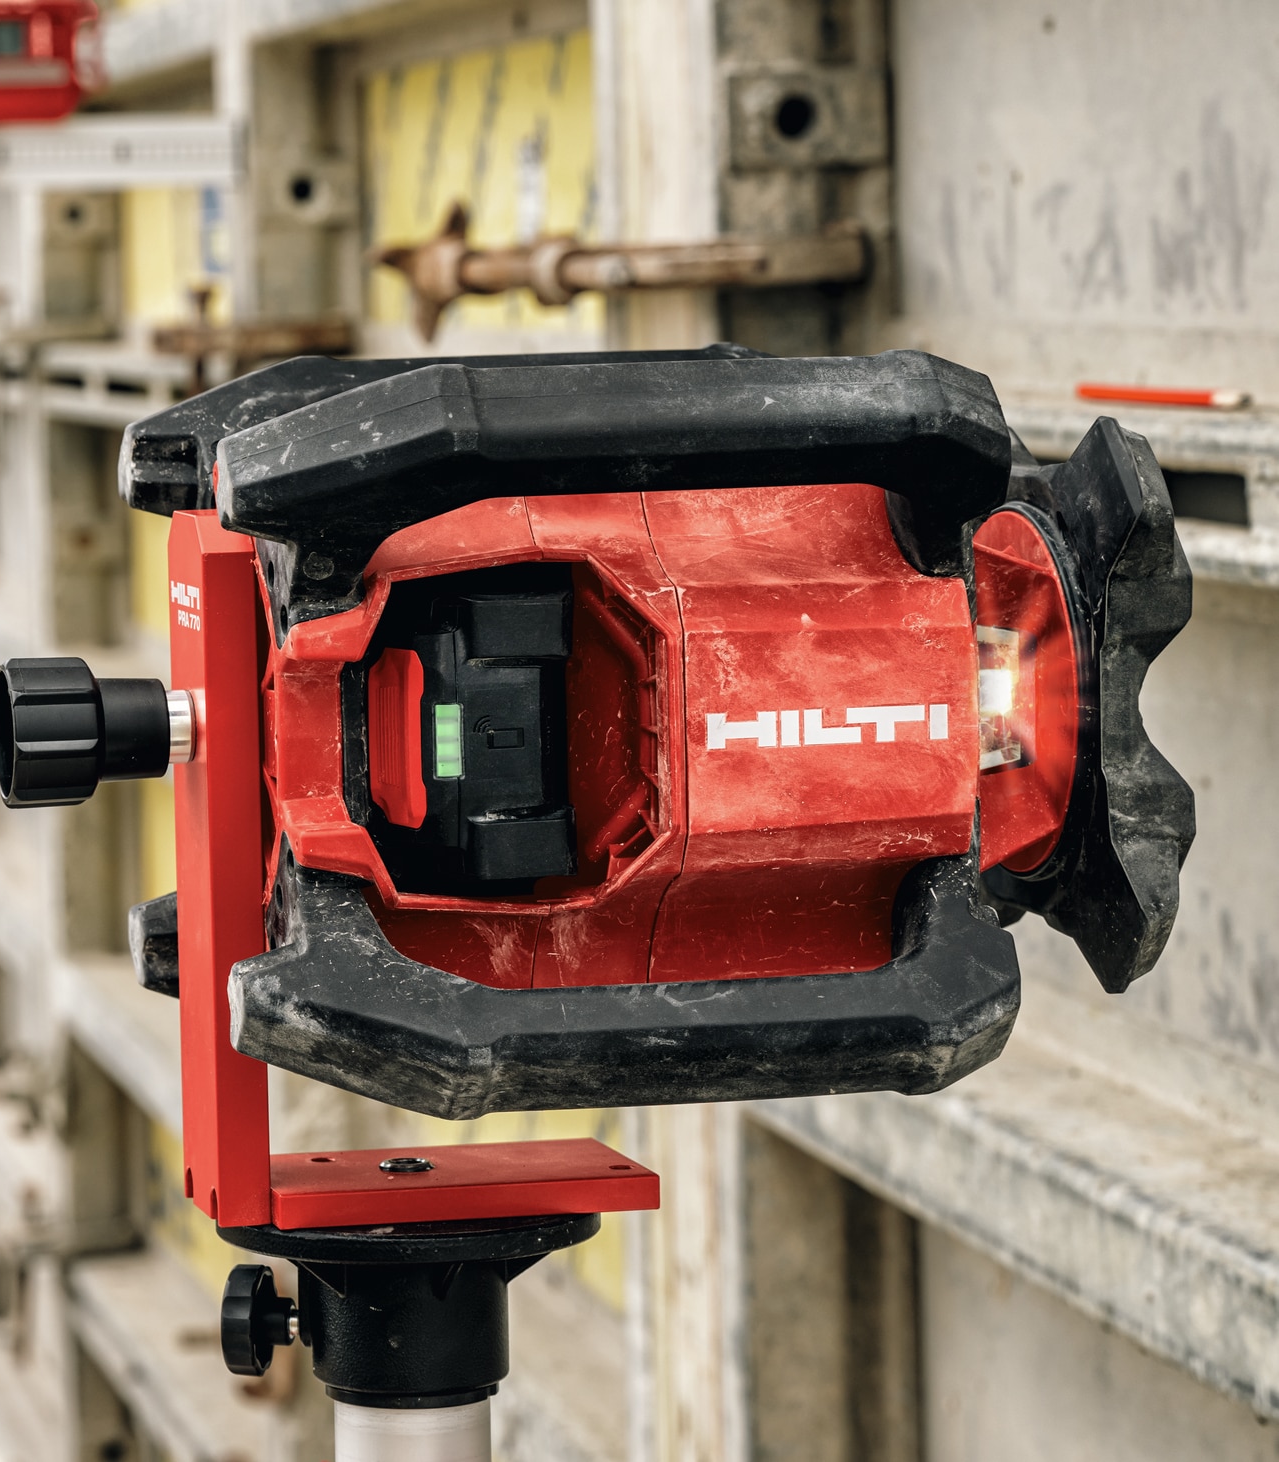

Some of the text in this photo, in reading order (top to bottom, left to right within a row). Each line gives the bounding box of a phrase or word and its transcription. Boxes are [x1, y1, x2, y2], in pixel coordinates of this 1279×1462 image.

[171, 580, 200, 610] HILTI
[177, 609, 201, 632] PRA 770
[706, 703, 949, 750] HILTI
